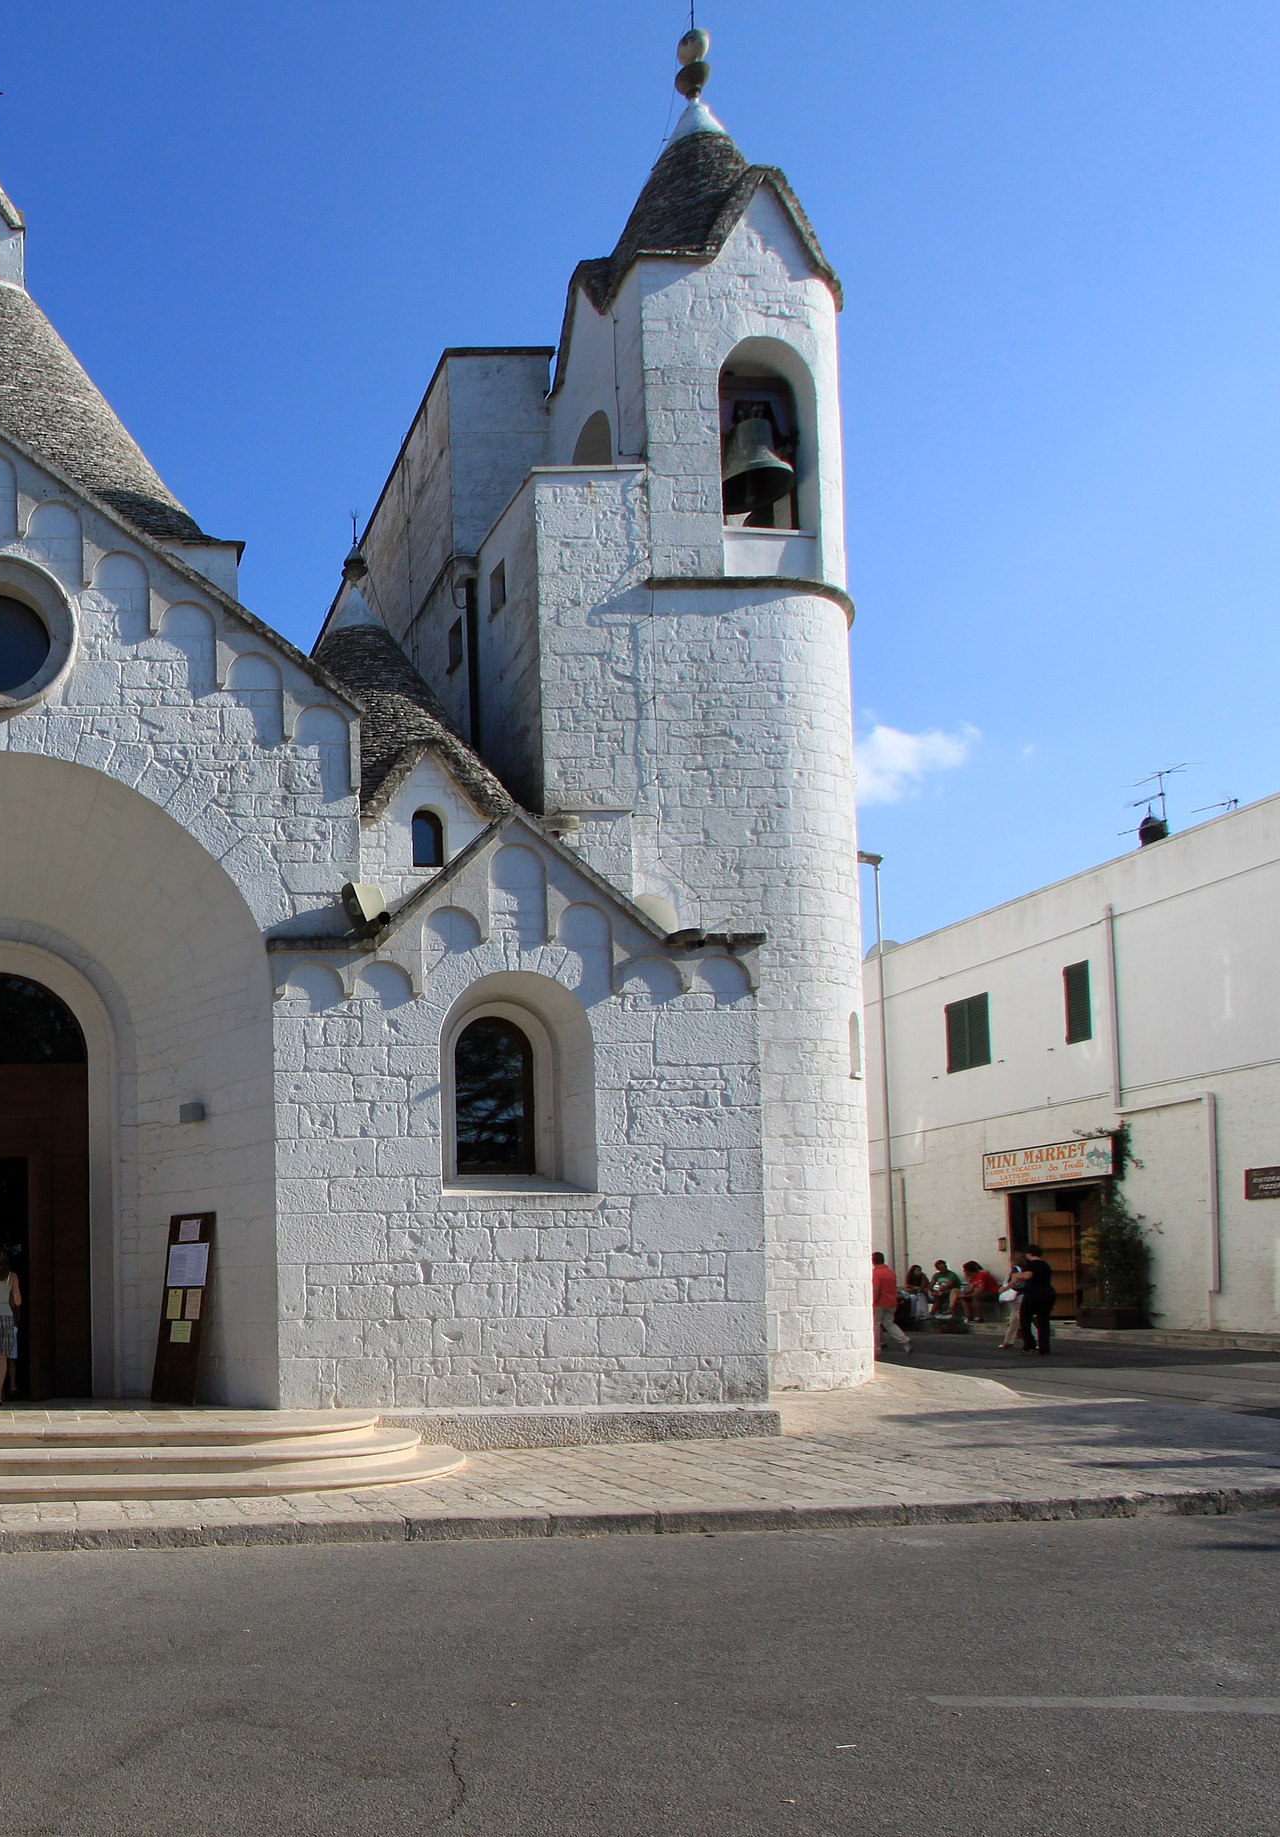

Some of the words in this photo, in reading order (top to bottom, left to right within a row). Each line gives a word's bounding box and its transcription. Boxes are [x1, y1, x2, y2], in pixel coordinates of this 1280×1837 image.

[986, 1153, 1017, 1169] MINI
[1023, 1142, 1087, 1164] MARKET
[1012, 1164, 1042, 1173] FOCACCIA
[1018, 1176, 1040, 1184] LOCALI
